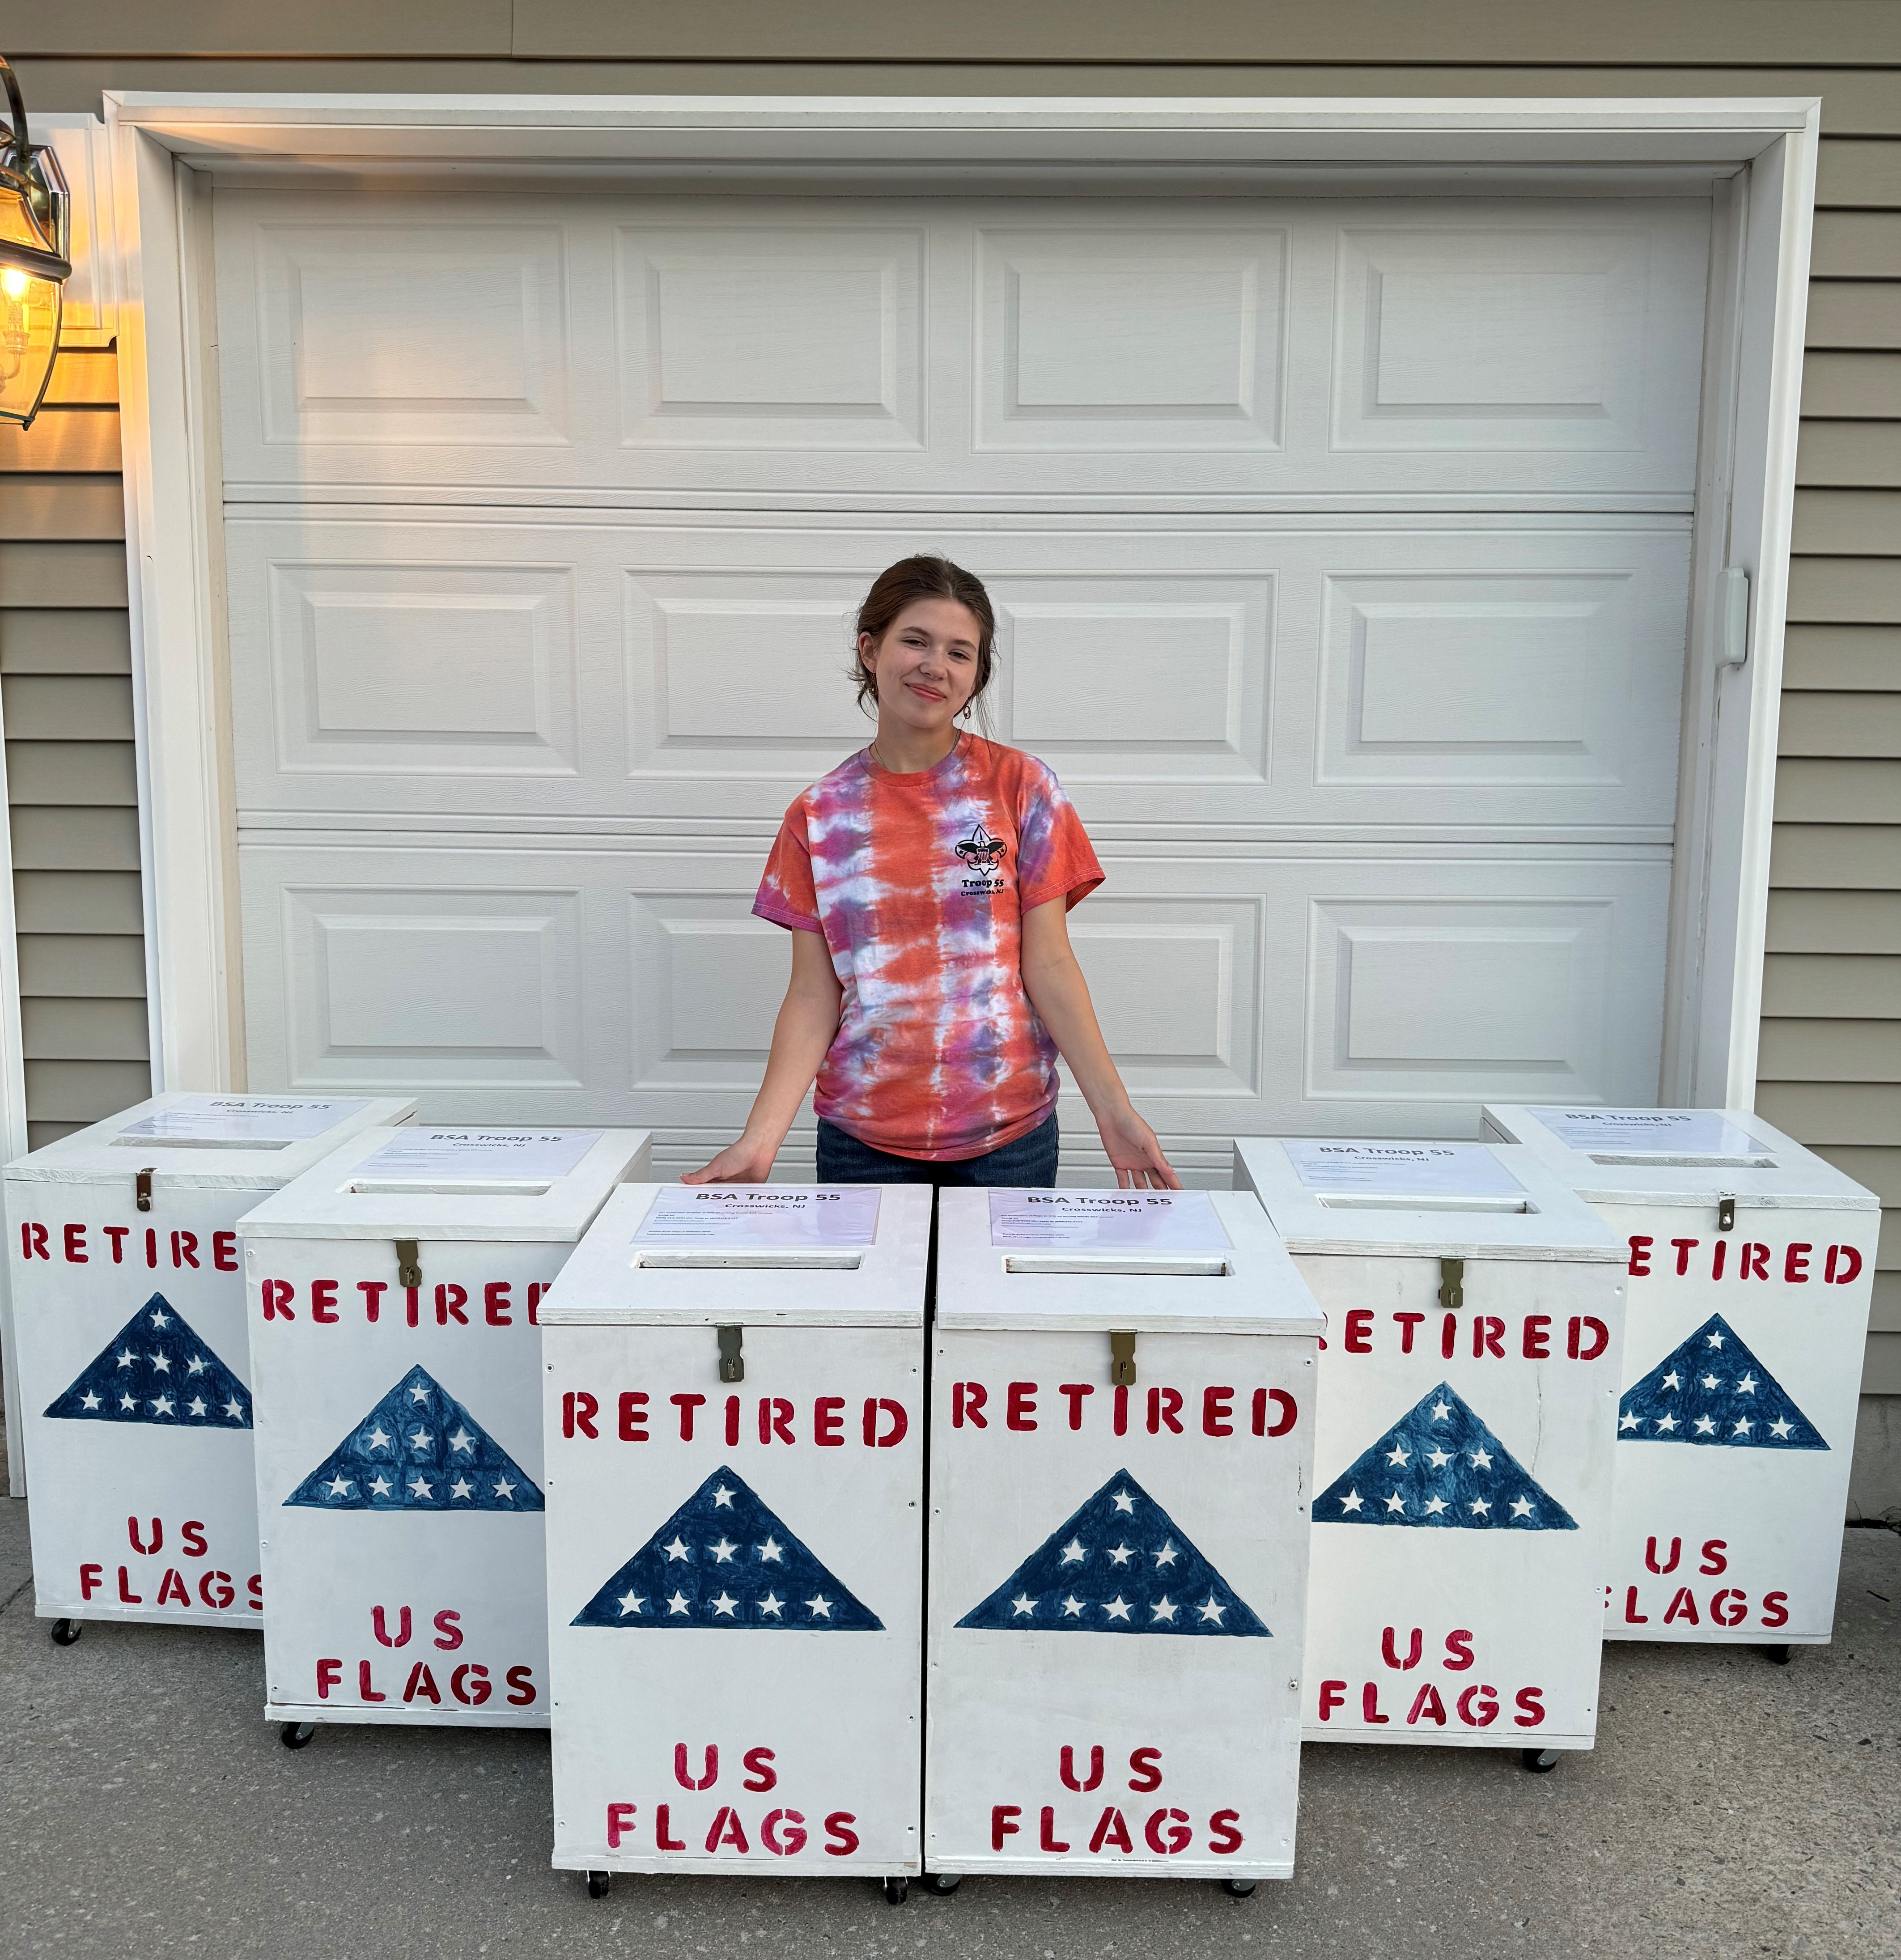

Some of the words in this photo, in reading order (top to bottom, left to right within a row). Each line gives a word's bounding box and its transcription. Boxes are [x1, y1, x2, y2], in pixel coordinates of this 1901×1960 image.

[962, 879, 992, 888] Troop
[746, 1194, 808, 1202] Troop
[1075, 1197, 1139, 1206] Troop
[21, 1222, 239, 1271] RETIRE
[1628, 1236, 1862, 1284] ETIRED
[1319, 1309, 1609, 1360] ETIRED
[563, 1392, 908, 1448] RETIRED
[952, 1382, 1298, 1438] RETIRED
[128, 1517, 208, 1557] US
[1646, 1536, 1727, 1575] US
[373, 1606, 463, 1650] US
[1605, 1586, 1789, 1627] LAGS
[1382, 1627, 1475, 1671] US
[316, 1659, 536, 1705] FLAGS
[1319, 1680, 1545, 1727] FLAGS
[674, 1743, 777, 1792] US
[1060, 1745, 1163, 1793] US
[607, 1803, 860, 1856] FLAGS
[992, 1805, 1243, 1854] FLAGS
